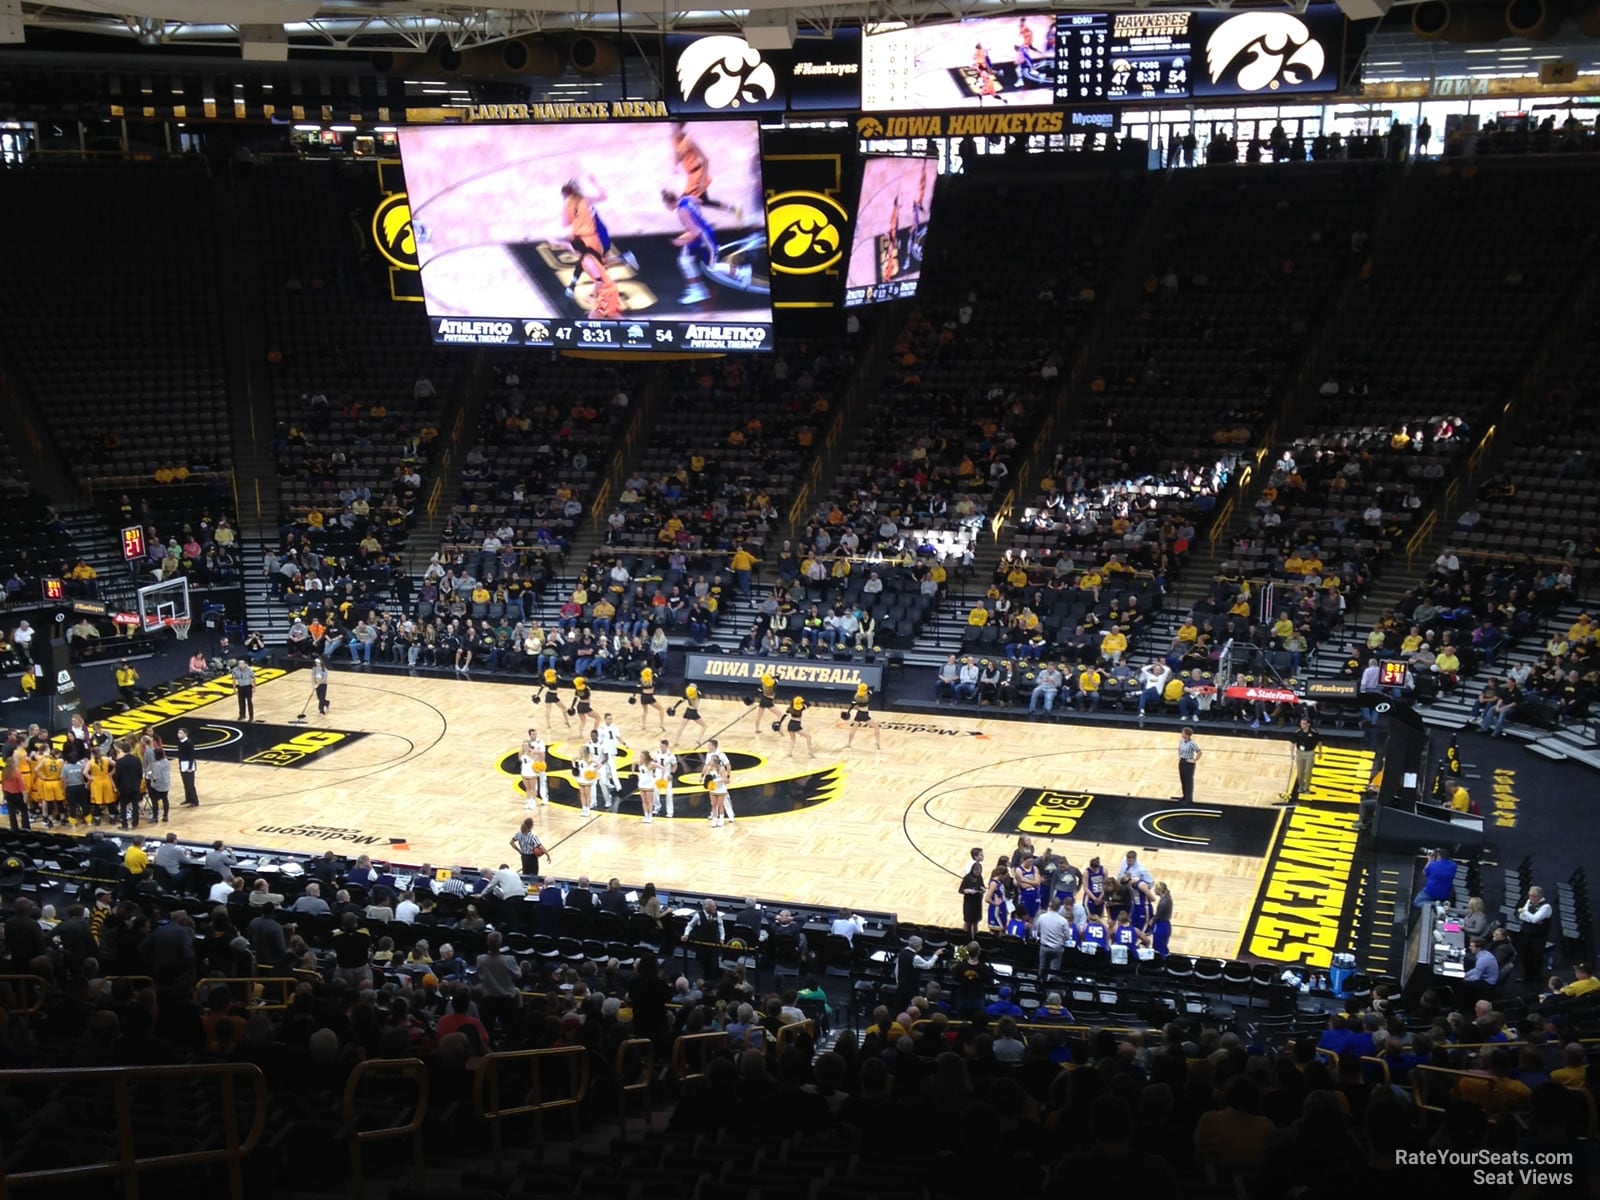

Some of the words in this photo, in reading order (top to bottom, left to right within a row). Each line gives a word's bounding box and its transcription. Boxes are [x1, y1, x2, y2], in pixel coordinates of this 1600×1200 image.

[1115, 13, 1190, 28] HAWKEYES
[1114, 28, 1143, 37] HOME
[1145, 26, 1188, 36] EVENTS
[1058, 47, 1069, 57] 11
[1080, 46, 1092, 57] 10
[1096, 46, 1105, 56] 0
[793, 61, 859, 76] #Hawkeyes
[1058, 60, 1069, 70] 12
[1096, 58, 1104, 69] 3
[1057, 74, 1067, 84] 21
[1079, 73, 1090, 83] 11
[1111, 72, 1131, 85] 47
[1136, 70, 1161, 83] 8:31
[1168, 69, 1187, 83] 54
[1433, 79, 1489, 96] IOWA
[469, 102, 610, 120] CARVER-HAWKEYE
[612, 100, 669, 117] ARENA
[885, 116, 942, 137] IOWA
[947, 112, 1064, 135] HAWKEYES
[1072, 112, 1113, 126] Mycogen
[438, 318, 513, 335] ATHLETICO
[555, 327, 572, 340] 47
[685, 324, 766, 341] ATHLETICO
[582, 328, 612, 343] 8:31
[656, 329, 673, 342] 54
[126, 539, 140, 556] 27
[704, 659, 750, 677] IOWA
[752, 663, 862, 685] BASKETBALL
[1385, 671, 1400, 682] 27
[1309, 683, 1355, 695] #Hawkeyes
[1298, 746, 1376, 804] IOWA
[256, 825, 382, 845] Mediacom
[1249, 805, 1360, 969] HAWKEYES
[1088, 926, 1104, 938] 45
[1120, 930, 1132, 943] 21
